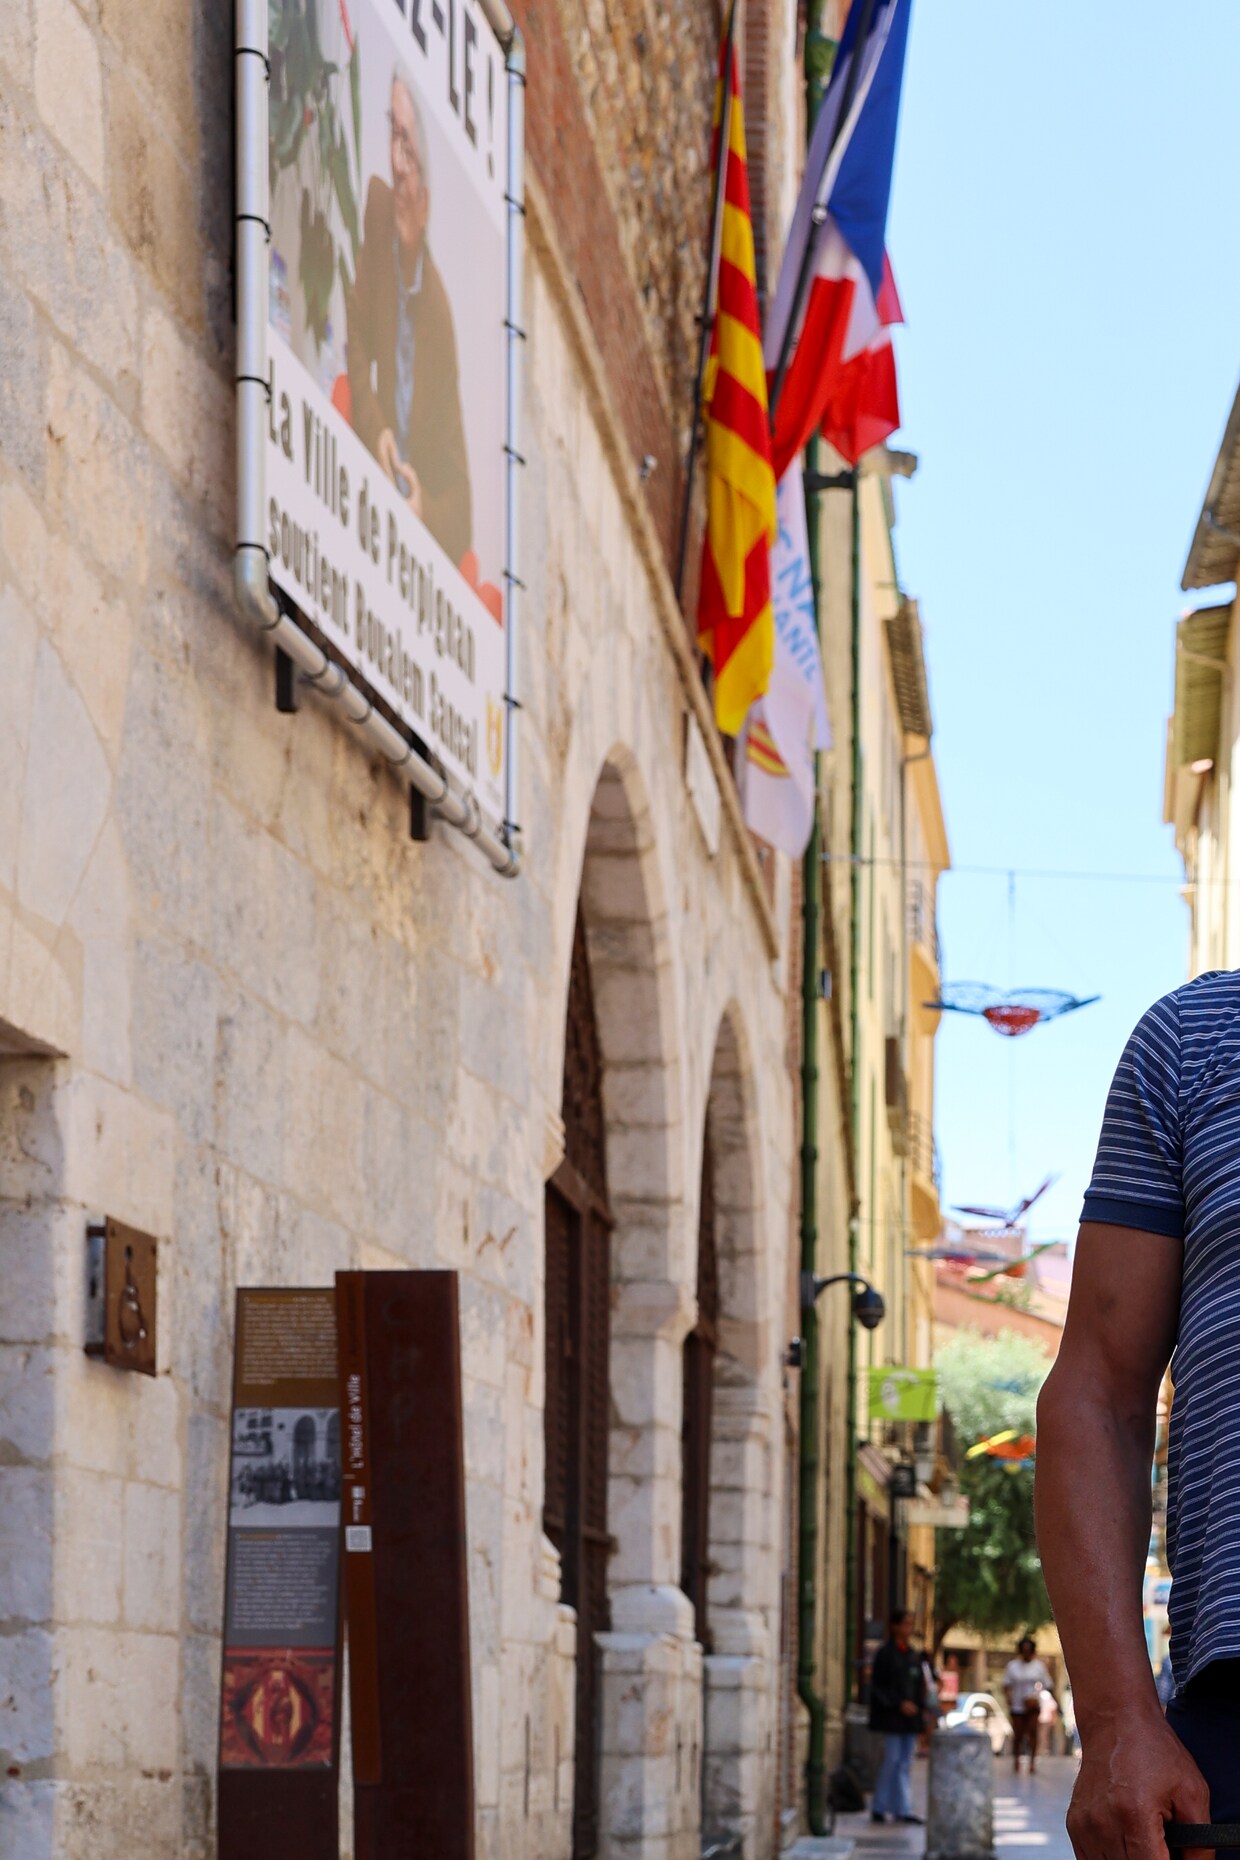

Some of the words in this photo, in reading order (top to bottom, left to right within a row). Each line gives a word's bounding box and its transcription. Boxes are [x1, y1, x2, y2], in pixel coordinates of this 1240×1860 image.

[269, 358, 293, 463] La
[302, 398, 349, 528] Ville
[358, 475, 380, 567] de
[388, 509, 475, 685] Perpignan
[269, 496, 350, 636] soutient
[355, 580, 425, 722] Boualem
[429, 670, 478, 779] Sansal
